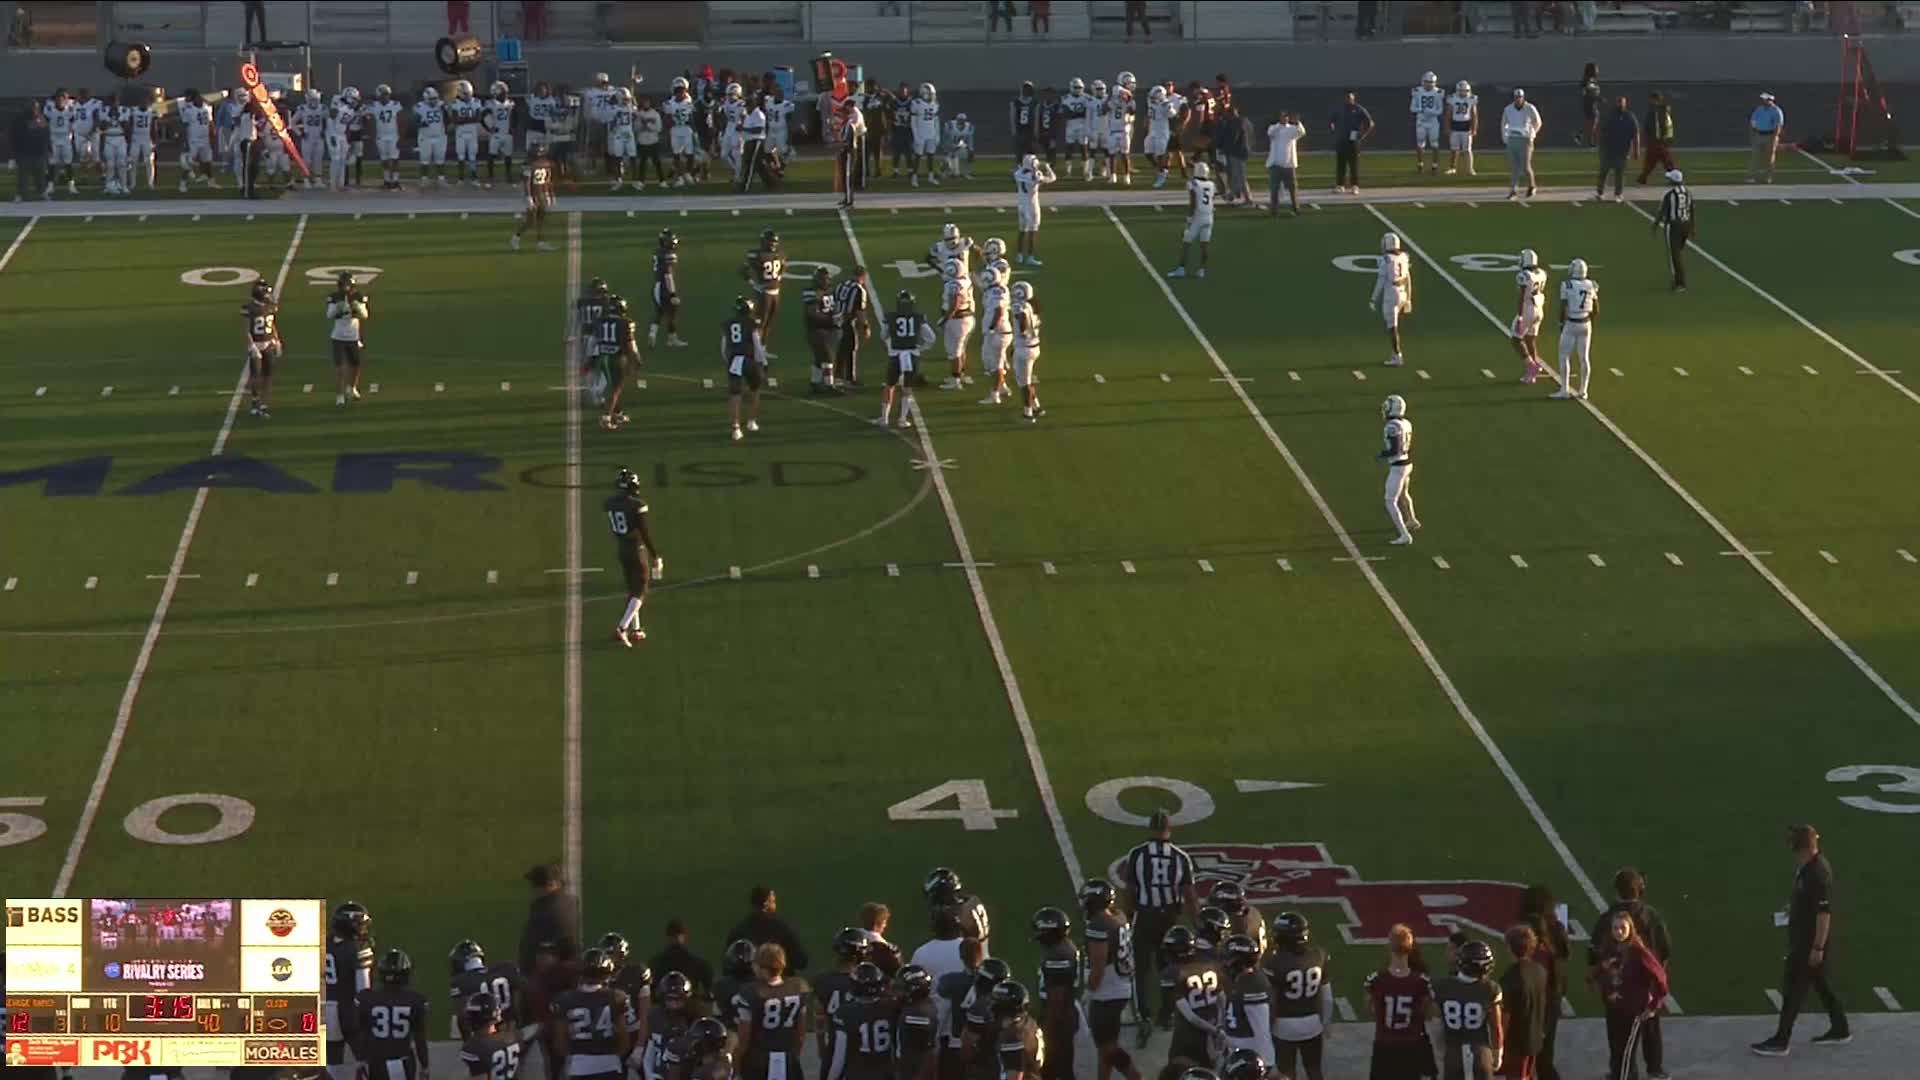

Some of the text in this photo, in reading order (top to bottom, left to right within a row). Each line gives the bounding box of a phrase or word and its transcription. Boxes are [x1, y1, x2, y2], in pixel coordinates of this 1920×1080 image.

[136, 114, 149, 129] 21
[378, 109, 393, 124] 47
[426, 110, 441, 123] 55
[1019, 111, 1029, 125] 6
[1202, 188, 1211, 205] 5
[1578, 289, 1589, 310] 7
[602, 321, 617, 342] 11
[730, 322, 742, 343] 8
[896, 316, 916, 337] 31
[608, 510, 628, 535] 18
[1150, 857, 1173, 885] H
[1186, 970, 1219, 1008] 22
[1284, 966, 1323, 999] 38
[371, 1005, 412, 1039] 35
[566, 1006, 614, 1040] 24
[762, 995, 800, 1030] 87
[1384, 996, 1413, 1029] 15
[1442, 1000, 1483, 1030] 88
[858, 1019, 890, 1053] 16
[490, 1042, 521, 1080] 25
